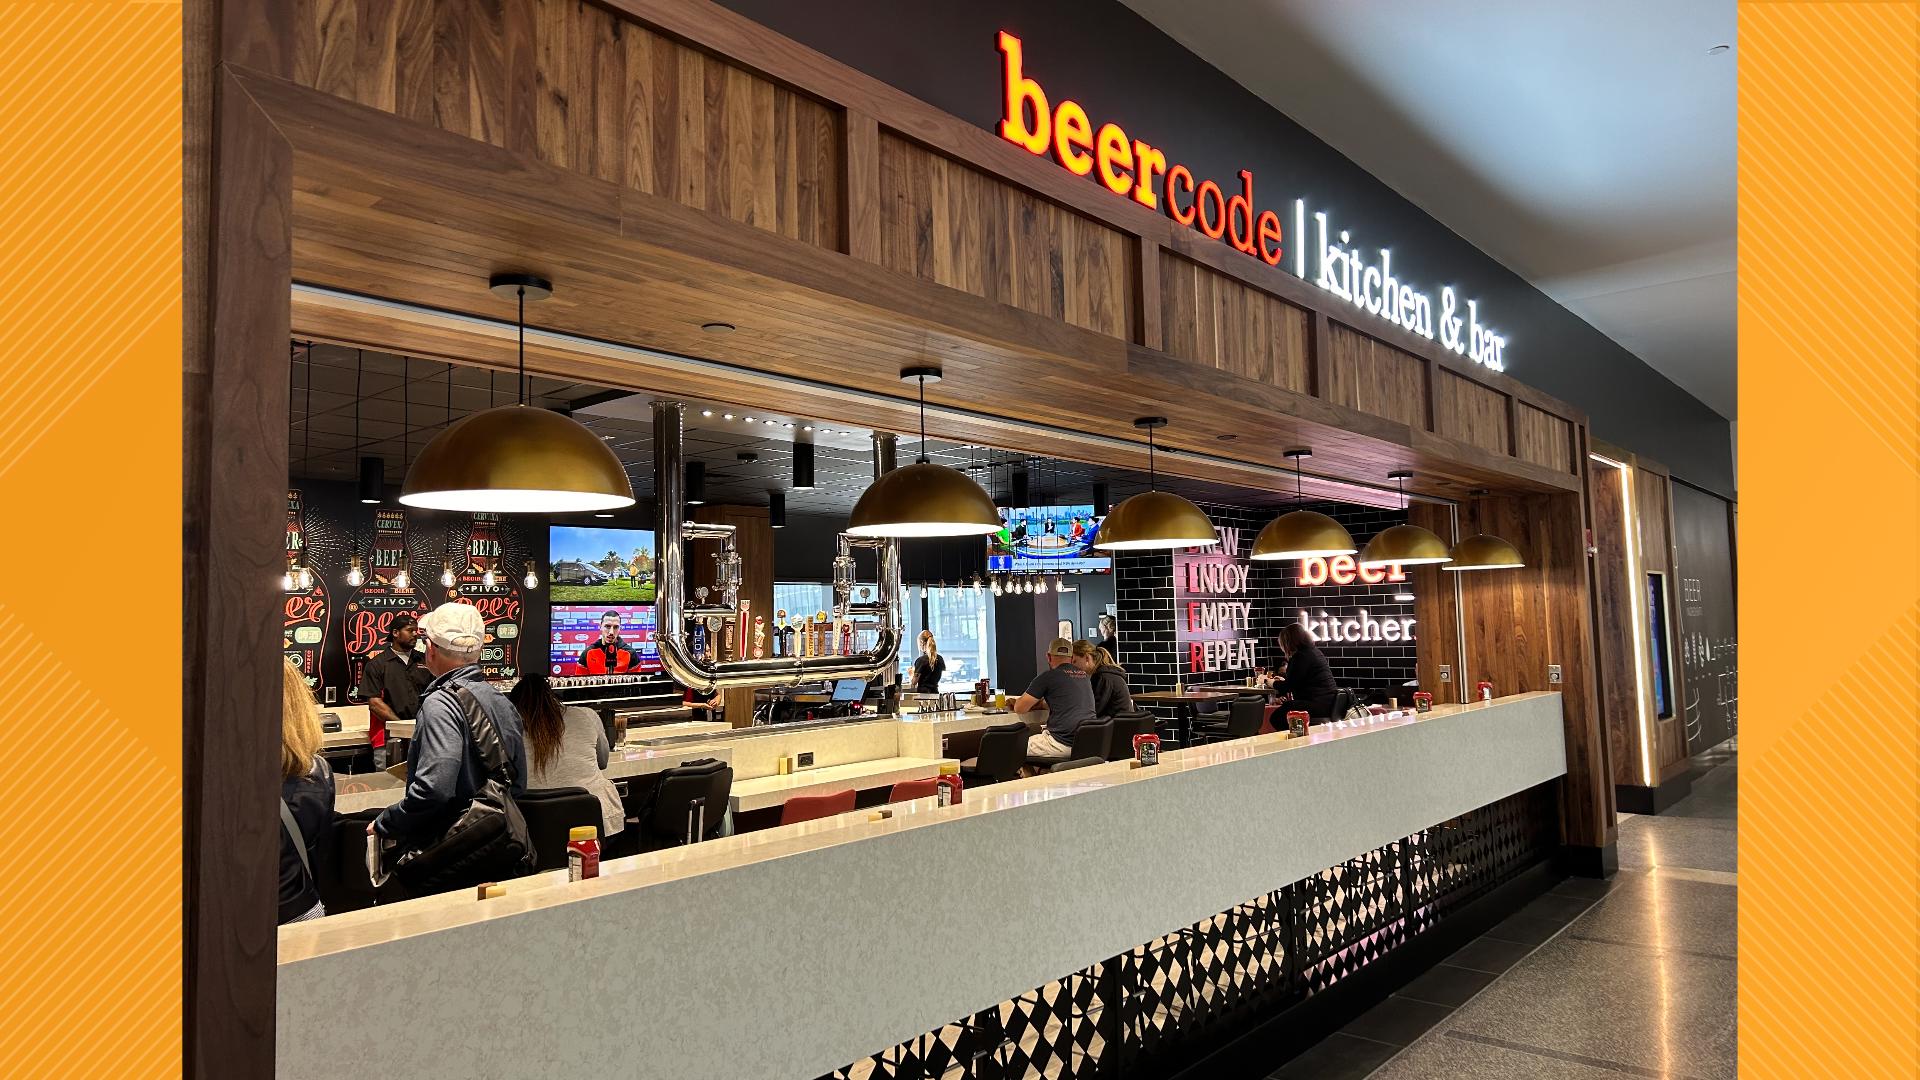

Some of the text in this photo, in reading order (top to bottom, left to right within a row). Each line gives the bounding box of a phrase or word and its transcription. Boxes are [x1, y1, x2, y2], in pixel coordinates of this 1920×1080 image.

[997, 30, 1283, 266] beercode
[1315, 212, 1434, 340] kitchen
[1440, 286, 1465, 355] &
[1468, 300, 1505, 373] bar
[471, 585, 500, 593] PIVO
[1188, 562, 1249, 594] ENJOY
[285, 596, 324, 624] er
[373, 598, 406, 606] PIVO
[453, 596, 519, 621] eer
[1188, 602, 1251, 634] EMPTY
[1190, 639, 1259, 673] REPEAT
